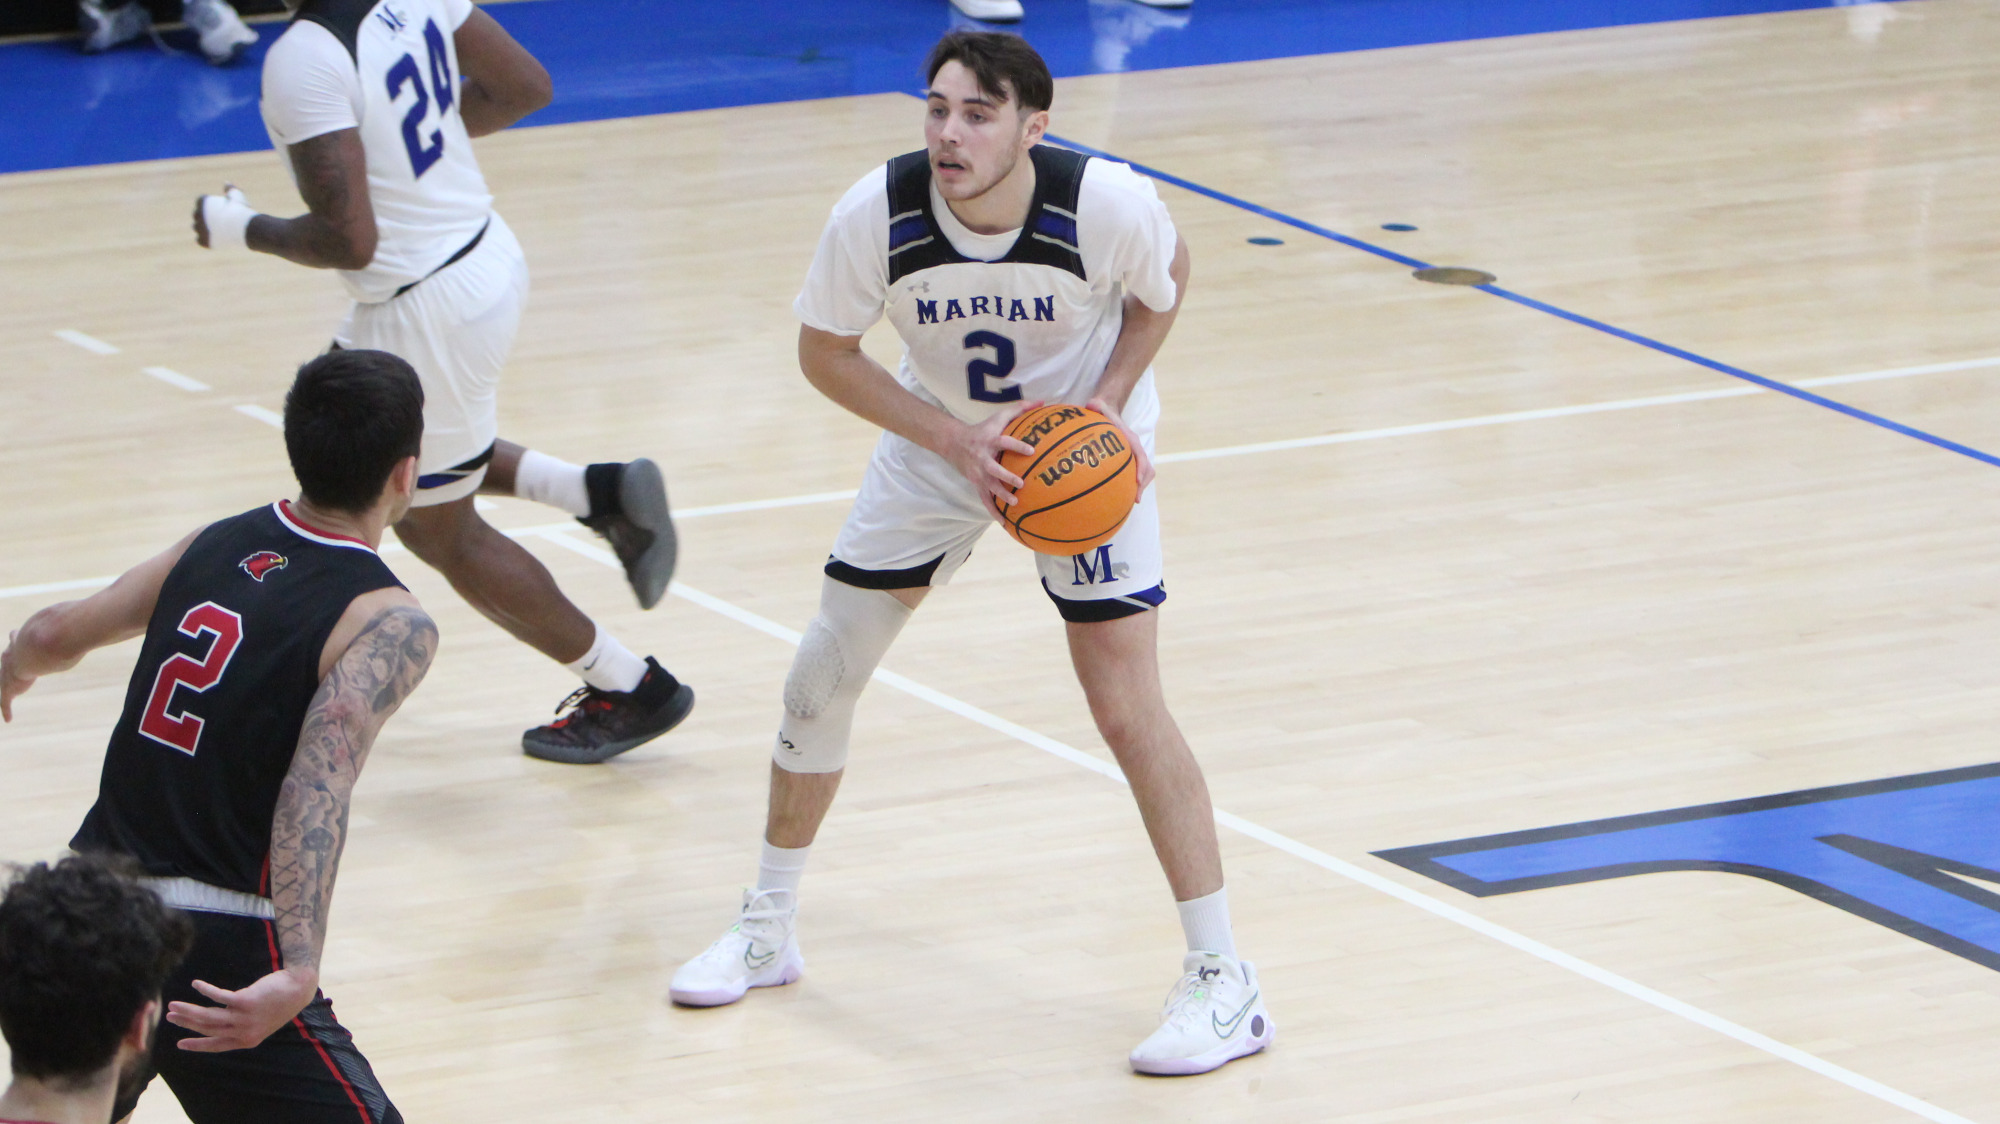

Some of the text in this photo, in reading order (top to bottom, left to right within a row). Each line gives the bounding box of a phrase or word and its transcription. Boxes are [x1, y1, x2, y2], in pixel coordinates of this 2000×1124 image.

[384, 16, 454, 181] 24
[915, 294, 1056, 325] MARIAN
[962, 328, 1024, 403] 2
[1038, 430, 1126, 487] Wilson
[1071, 543, 1119, 586] M
[138, 600, 244, 757] 2
